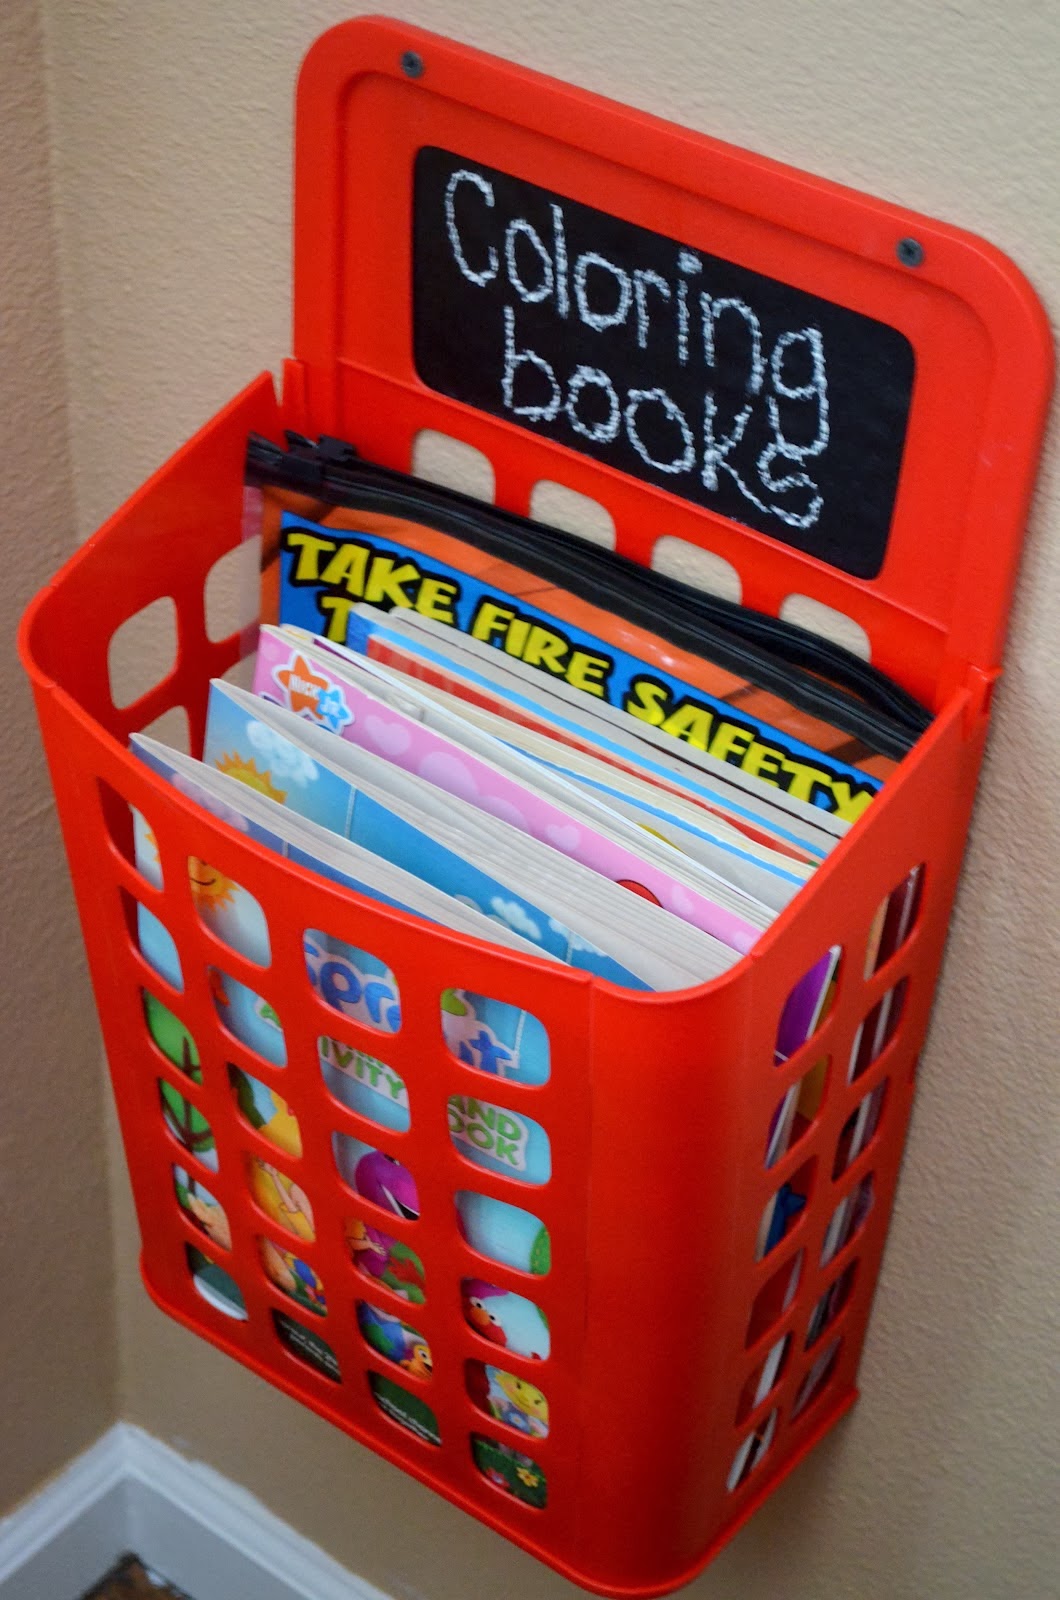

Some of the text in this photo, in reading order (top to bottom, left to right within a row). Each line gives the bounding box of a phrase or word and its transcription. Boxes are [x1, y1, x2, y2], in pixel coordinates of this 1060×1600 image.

[445, 168, 829, 460] Coloring
[501, 304, 825, 529] books
[286, 532, 876, 825] TAKE FIRE SAFETY
